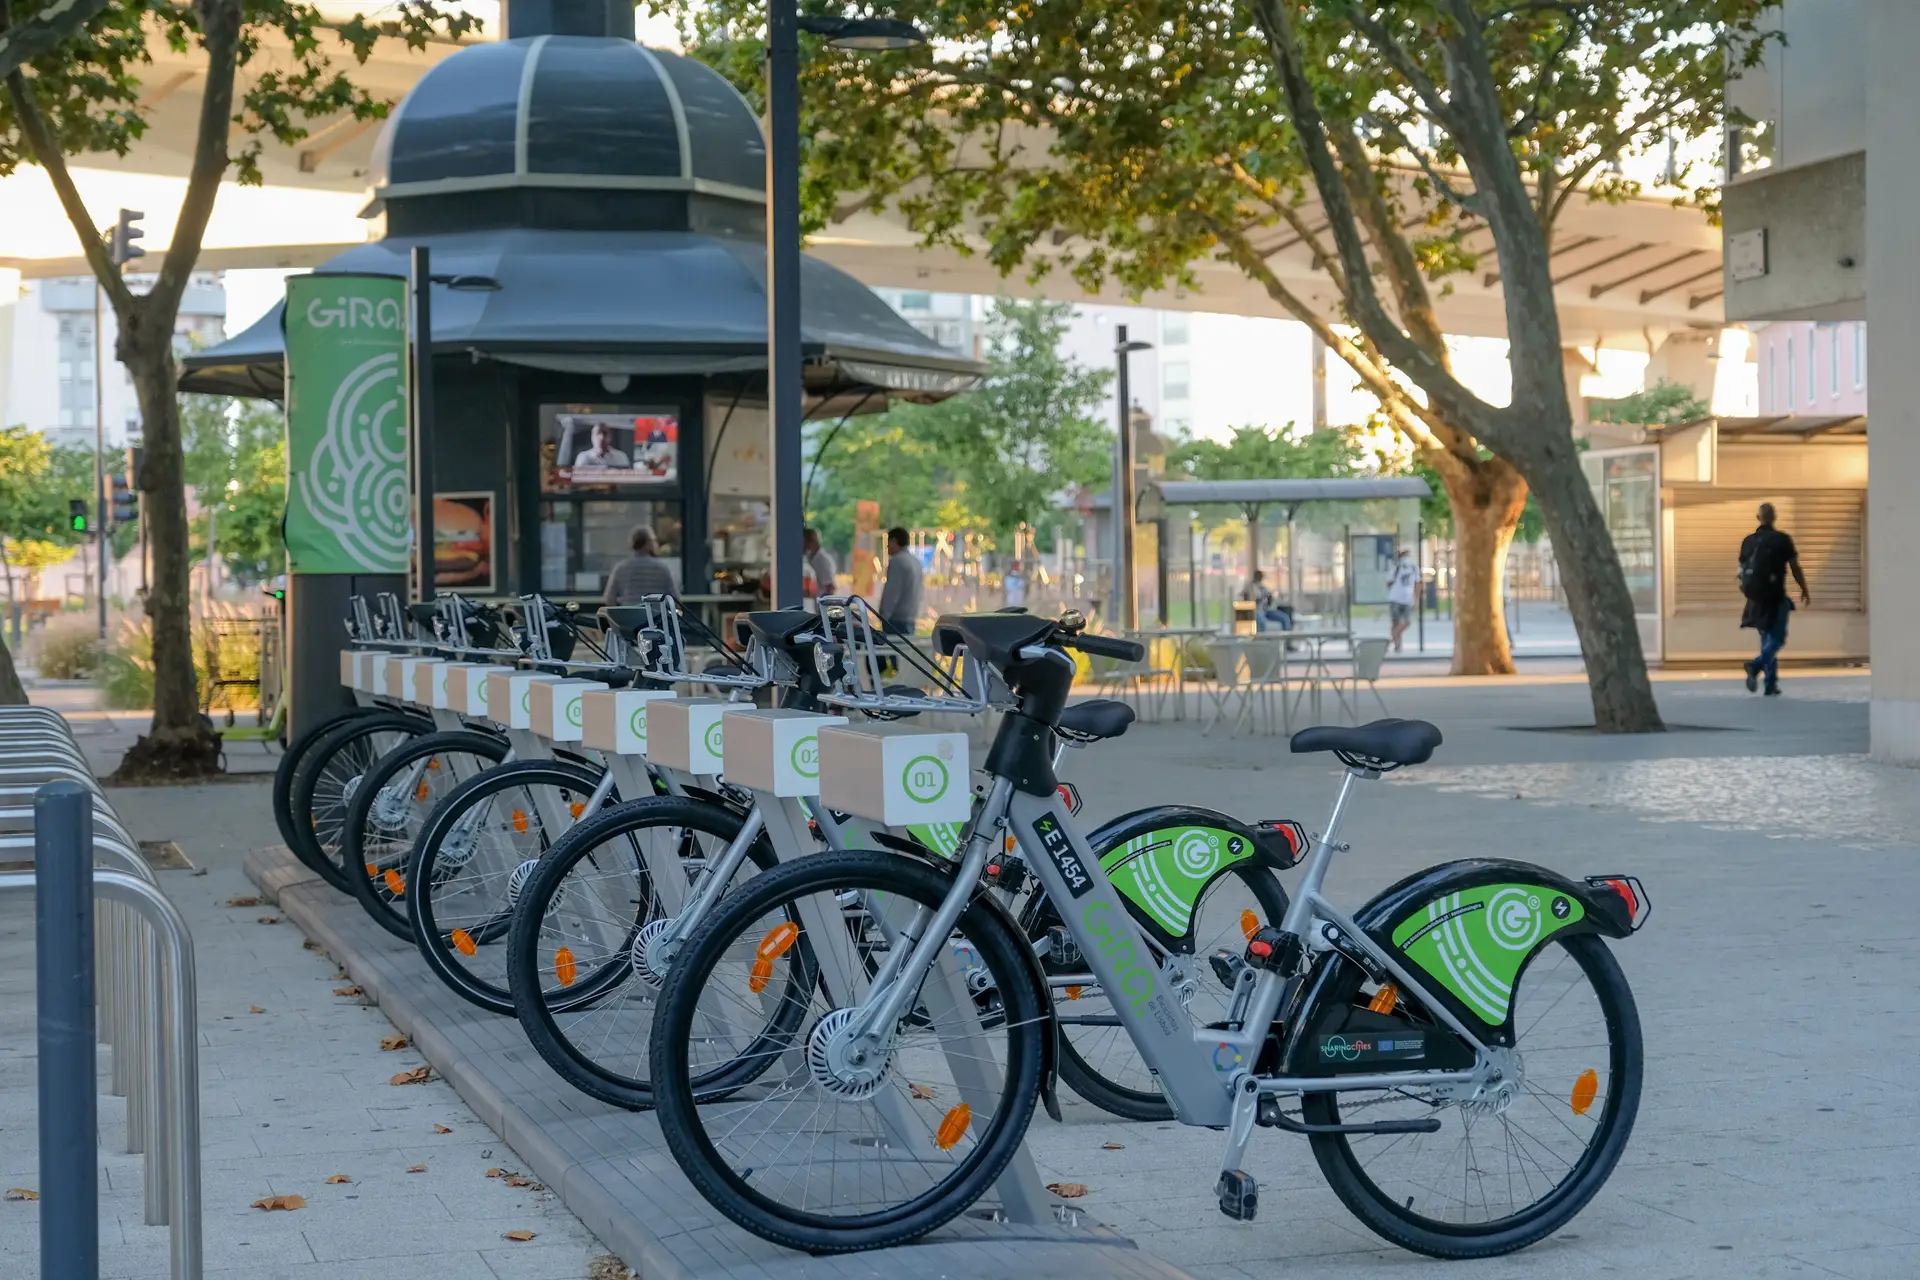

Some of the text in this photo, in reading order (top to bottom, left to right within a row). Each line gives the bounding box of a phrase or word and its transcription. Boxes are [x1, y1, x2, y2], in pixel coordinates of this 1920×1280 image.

[801, 749, 819, 764] 02
[914, 771, 937, 788] 01
[1053, 844, 1087, 889] 1454
